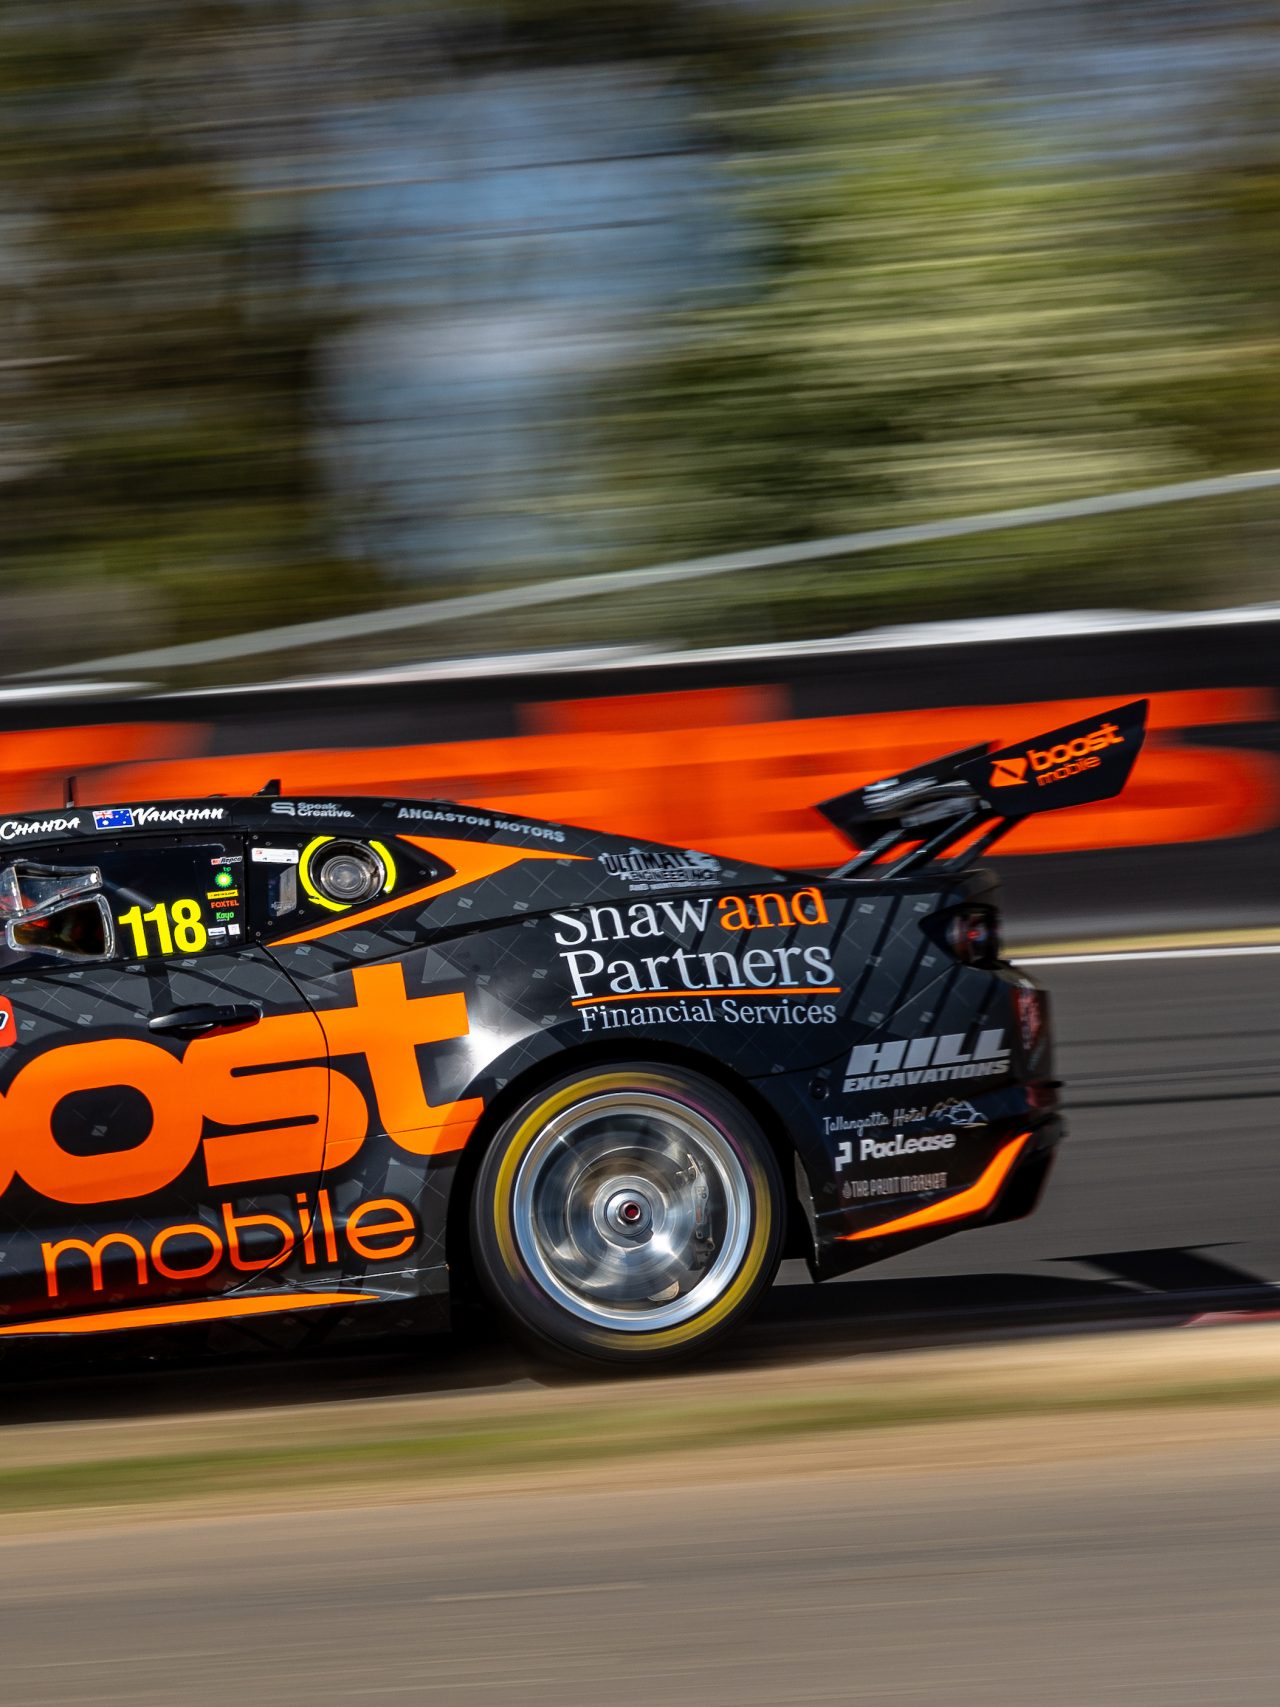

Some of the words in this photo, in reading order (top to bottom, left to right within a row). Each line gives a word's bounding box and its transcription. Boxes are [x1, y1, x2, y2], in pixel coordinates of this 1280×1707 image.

[1027, 723, 1124, 771] boost
[1036, 757, 1101, 786] mobile
[297, 802, 337, 812] Speak
[397, 807, 491, 827] ANGASTON
[494, 820, 566, 843] MOTORS
[210, 900, 240, 909] FOXTEL
[216, 912, 234, 921] Kayo
[718, 887, 829, 931] and
[118, 898, 207, 957] 118
[560, 946, 835, 999] Partners
[578, 999, 716, 1032] Financial
[721, 999, 837, 1024] Services
[845, 1028, 1011, 1076] HILL
[842, 1059, 1010, 1093] EXCAVATIONS
[893, 1107, 927, 1126] Hotel
[860, 1133, 956, 1161] PacLease
[41, 1190, 416, 1296] mobile
